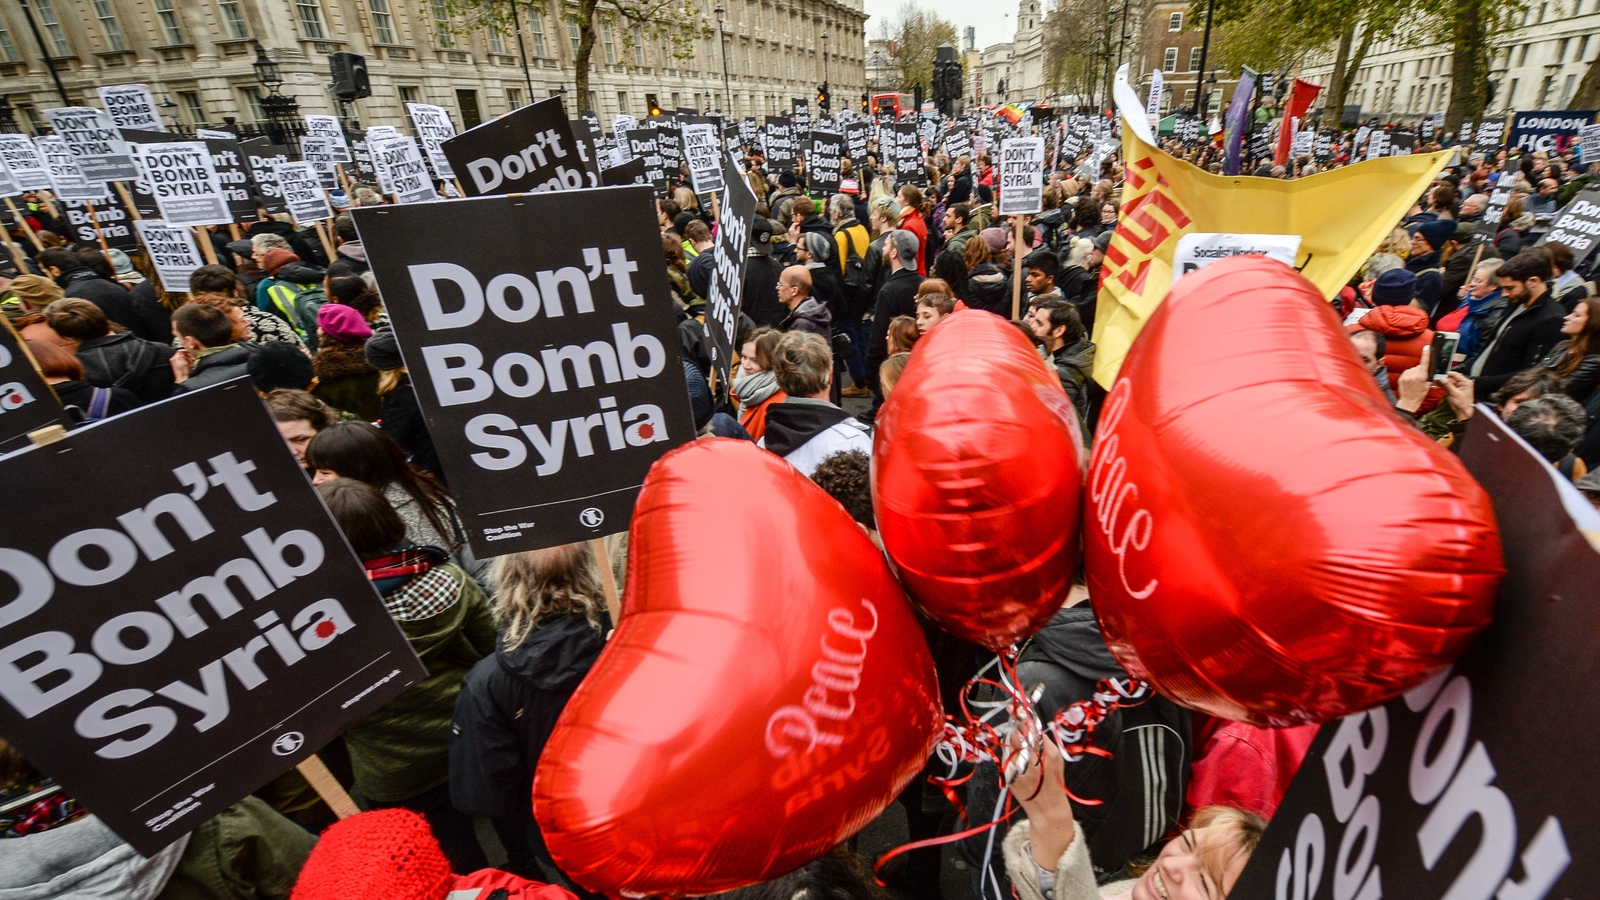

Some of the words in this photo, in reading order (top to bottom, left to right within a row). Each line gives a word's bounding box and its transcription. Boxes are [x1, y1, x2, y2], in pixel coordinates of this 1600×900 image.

[104, 93, 146, 106] DON'T
[110, 104, 151, 116] BOMB
[52, 116, 99, 130] DON'T
[115, 114, 156, 126] SYRIA
[414, 112, 442, 126] DON'T
[1517, 116, 1588, 130] LONDON
[62, 128, 120, 143] ATTACK
[420, 126, 454, 138] ATTACK
[766, 124, 790, 136] Don't
[848, 128, 864, 140] Don't
[658, 132, 679, 146] Don't
[686, 134, 708, 146] DON'T
[766, 136, 790, 148] Bomb
[848, 138, 866, 150] Bomb
[896, 132, 916, 144] Don't
[68, 142, 114, 156] SYRIA
[630, 138, 658, 153] Don't
[690, 144, 717, 158] ATTACK
[814, 140, 840, 155] Don't
[896, 145, 918, 158] Bomb
[144, 153, 202, 168] DON'T
[212, 150, 240, 166] n't
[383, 147, 412, 165] DON'T
[768, 148, 790, 162] Syria
[812, 154, 840, 168] Bomb
[850, 148, 867, 160] Syria
[1004, 148, 1036, 160] DON'T
[465, 128, 568, 195] Don't
[662, 156, 679, 168] yria
[692, 157, 714, 170] SYRIA
[898, 158, 918, 174] Syria
[1004, 160, 1042, 174] ATTACK
[50, 165, 79, 176] SYRI
[150, 167, 208, 183] BOMB
[218, 168, 246, 184] mb
[252, 170, 275, 182] Bo
[278, 170, 308, 181] DON'T
[390, 160, 425, 180] ATTACK
[645, 167, 664, 184] yria
[812, 168, 838, 183] Syria
[394, 175, 423, 193] SYRIA
[529, 164, 583, 192] mb
[1004, 174, 1032, 187] SYRIA
[156, 182, 215, 198] SYRIA
[283, 180, 320, 192] ATTACK
[222, 186, 249, 201] ria
[287, 190, 316, 202] SYRIA
[1569, 200, 1600, 218] Don
[720, 184, 746, 264] Don't
[78, 224, 130, 242] Sria
[143, 230, 184, 242] DON'T
[148, 242, 190, 254] BOMB
[154, 254, 196, 266] SYRIA
[714, 223, 742, 306] Bomb
[406, 247, 645, 332] Don't
[710, 268, 735, 345] Syria
[420, 322, 666, 407] Bomb
[464, 396, 670, 477] Syria
[1088, 377, 1158, 600] Peace
[502, 524, 518, 532] the
[0, 450, 278, 628] Don't
[486, 532, 522, 542] Coalition
[0, 526, 326, 720] Bomb
[74, 598, 357, 760] Syria
[765, 598, 878, 758] Peace
[152, 801, 202, 832] Coalition
